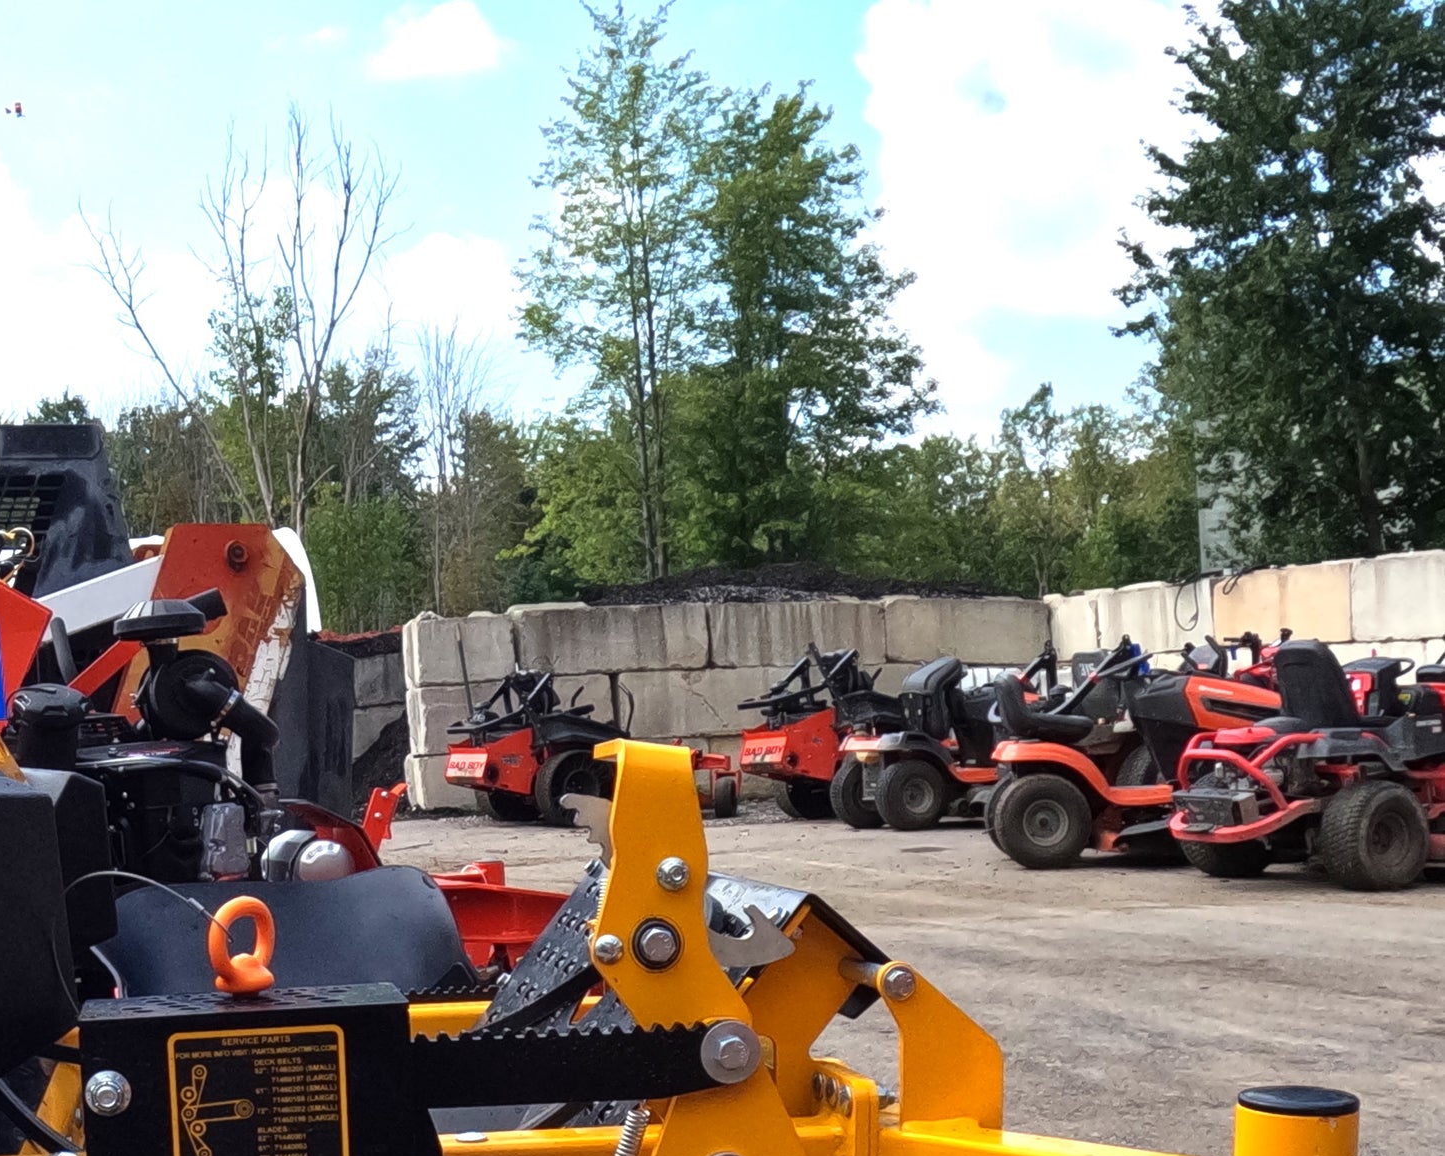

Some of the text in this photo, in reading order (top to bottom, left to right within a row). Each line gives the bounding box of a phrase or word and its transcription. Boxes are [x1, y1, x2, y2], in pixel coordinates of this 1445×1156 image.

[745, 746, 784, 756] BAD BOY
[222, 1035, 291, 1046] SERVICE PARTS
